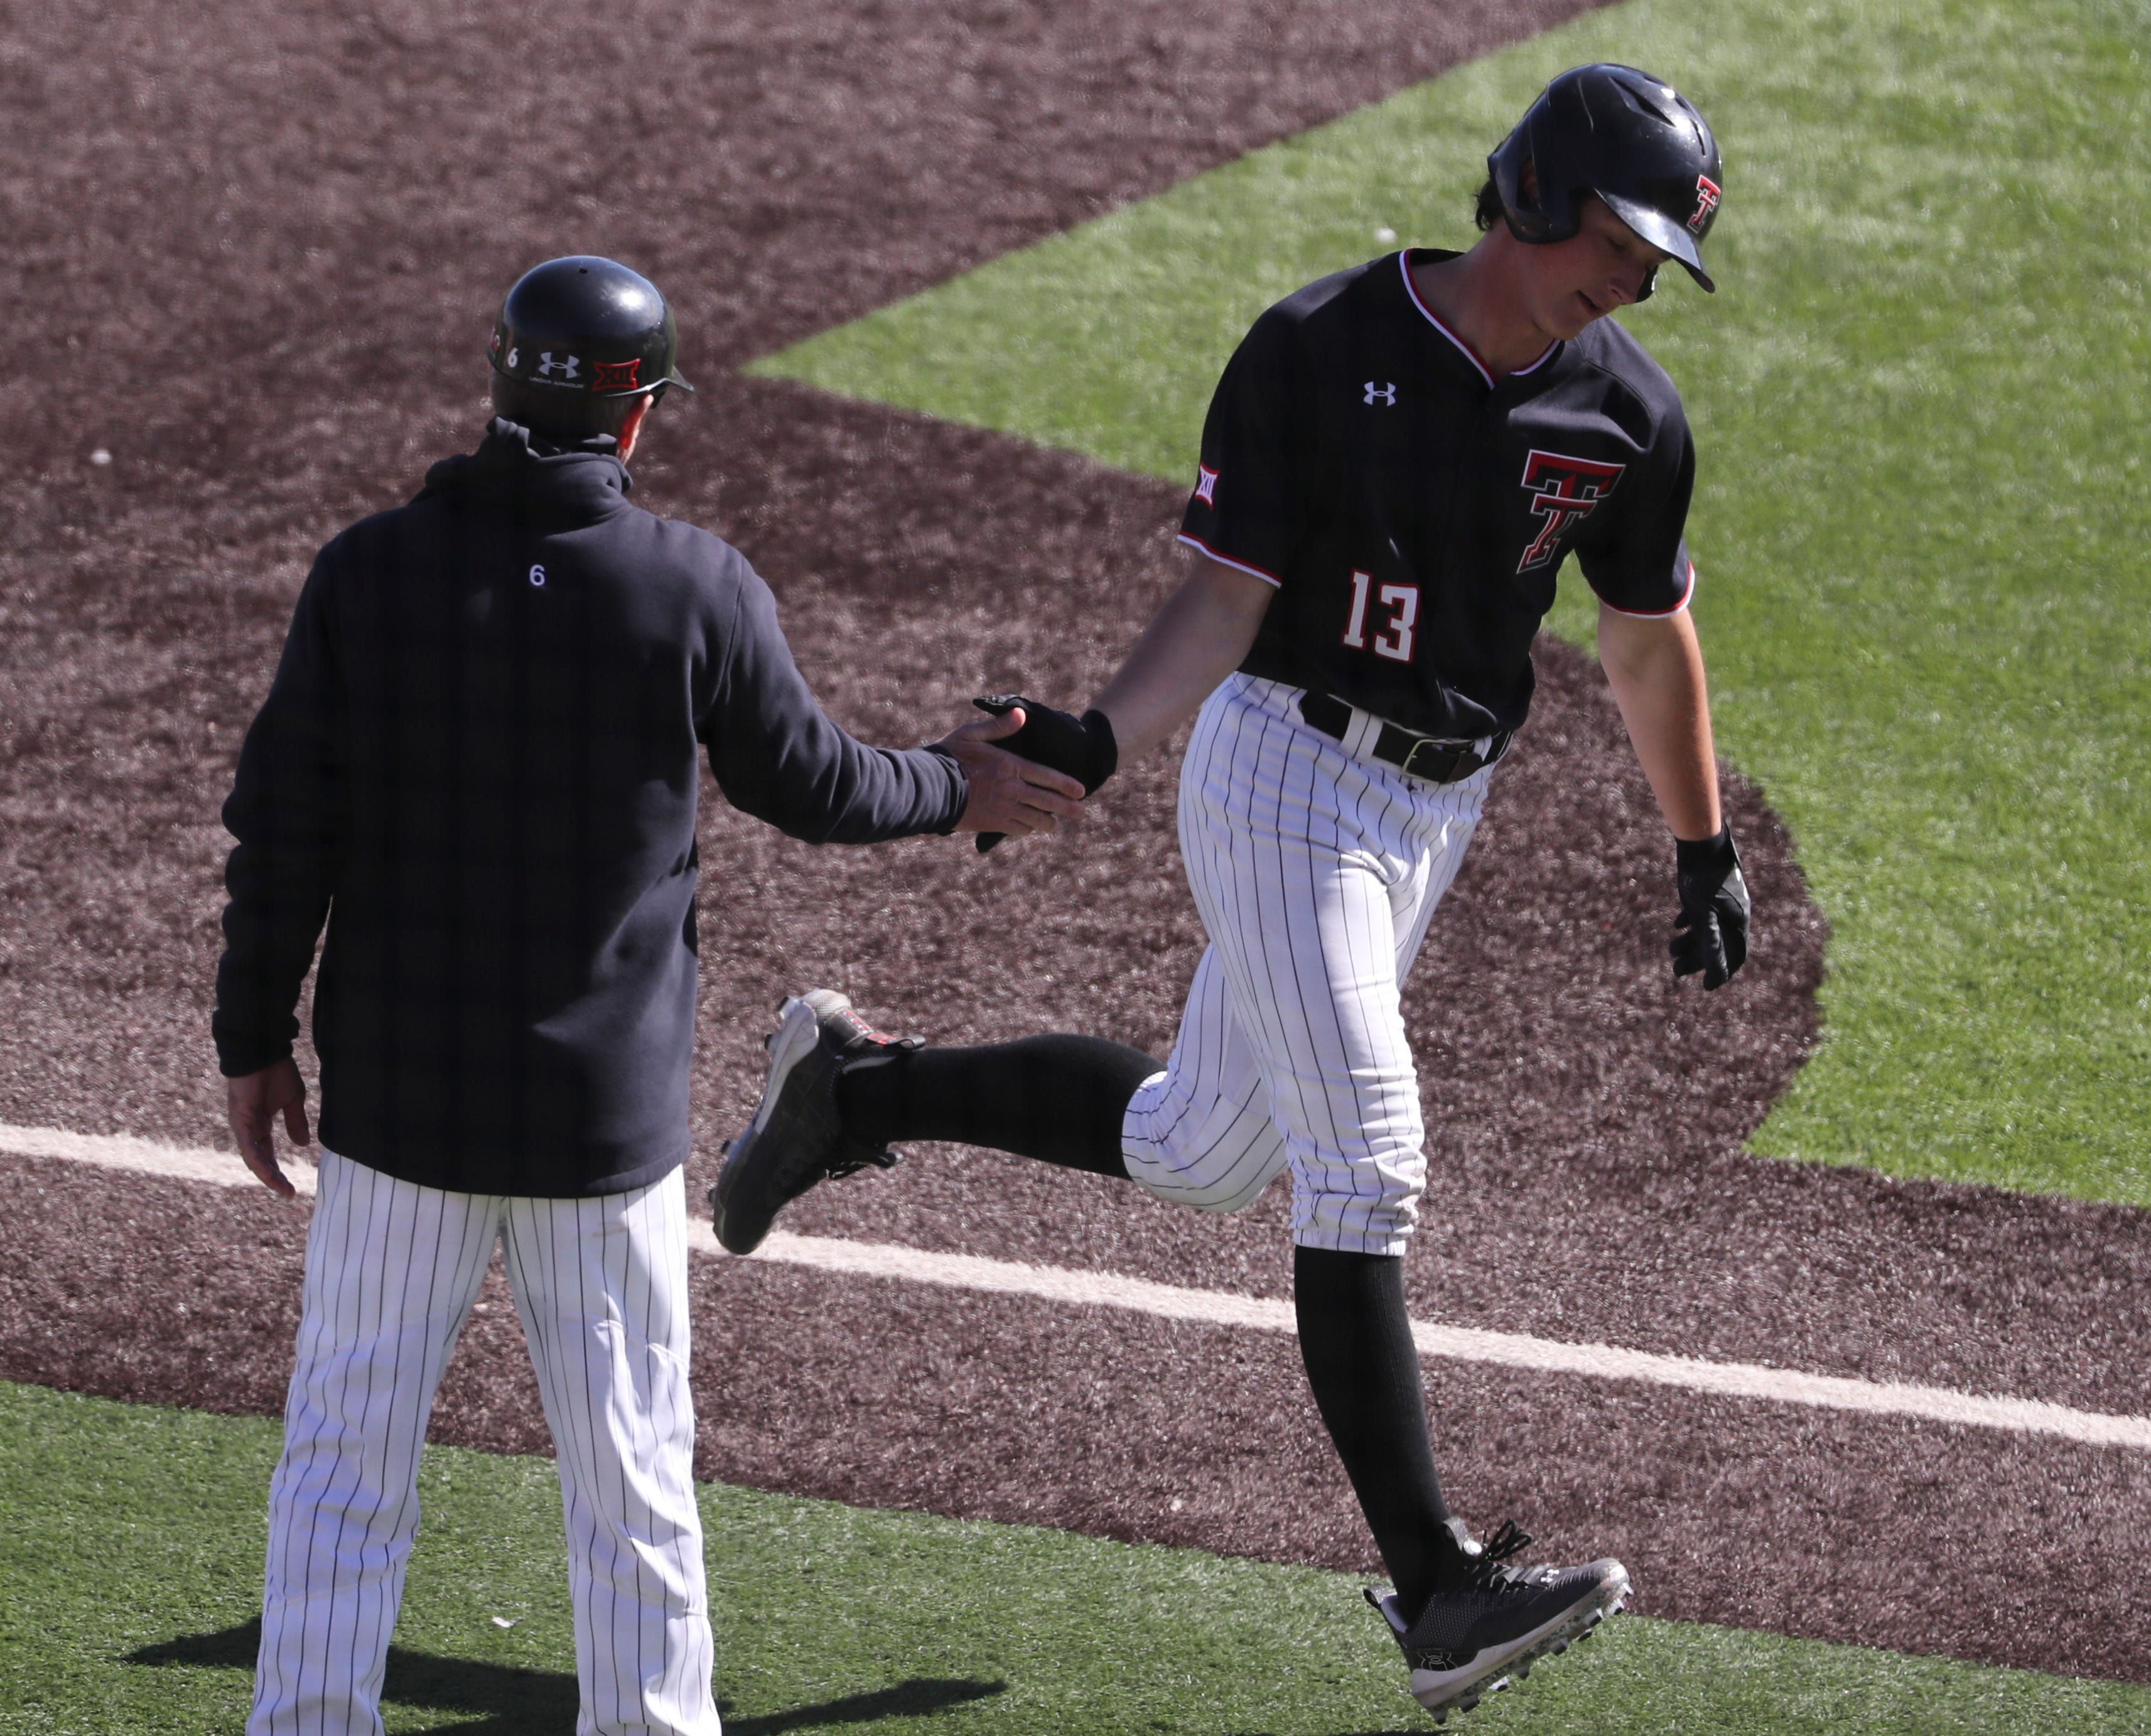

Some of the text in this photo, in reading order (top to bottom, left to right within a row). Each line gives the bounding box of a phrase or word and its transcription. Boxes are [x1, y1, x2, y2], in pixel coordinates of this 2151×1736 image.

[507, 347, 519, 368] 6
[529, 564, 545, 586] 6
[1341, 568, 1420, 664] 13
